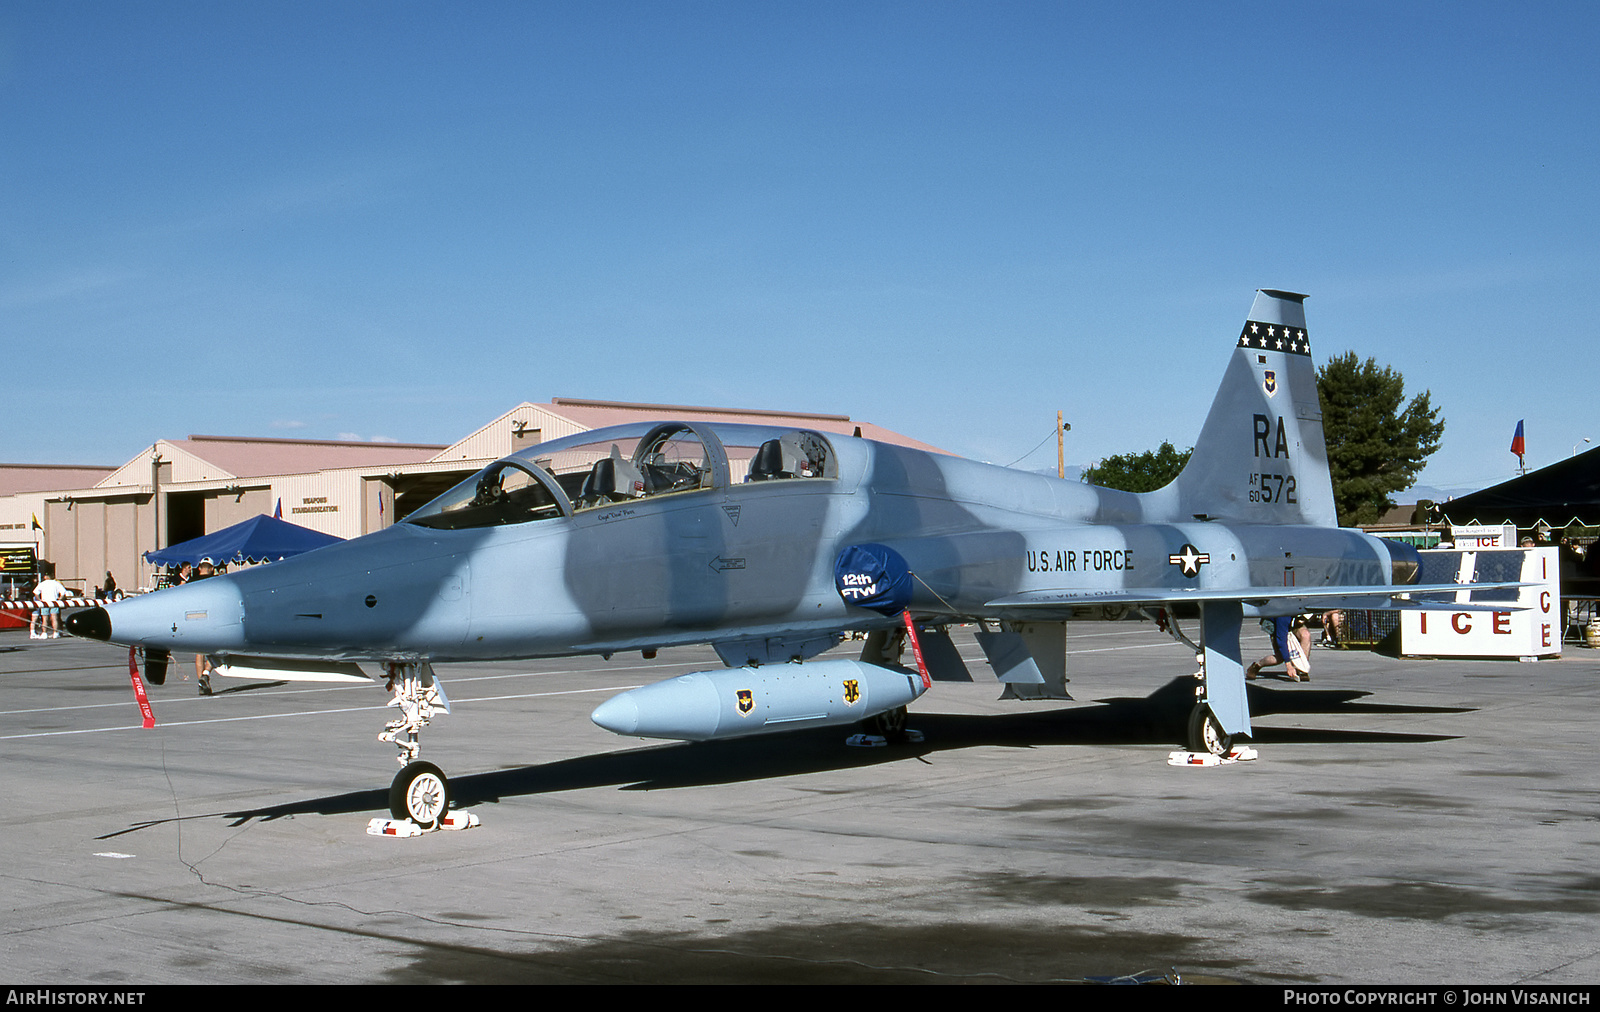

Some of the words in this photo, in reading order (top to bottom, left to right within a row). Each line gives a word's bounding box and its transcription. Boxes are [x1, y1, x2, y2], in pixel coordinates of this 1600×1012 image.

[1253, 413, 1290, 459] RA
[1249, 473, 1259, 485] AF
[1249, 490, 1260, 502] 60
[1261, 474, 1297, 504] 572
[1477, 536, 1500, 547] ICE
[1027, 551, 1053, 573] U.S.
[1055, 551, 1077, 572] AIR
[1083, 549, 1135, 572] FORCE
[841, 583, 877, 599] FTW
[842, 573, 872, 586] 12th
[1540, 557, 1552, 648] ICE
[1420, 611, 1512, 635] ICE
